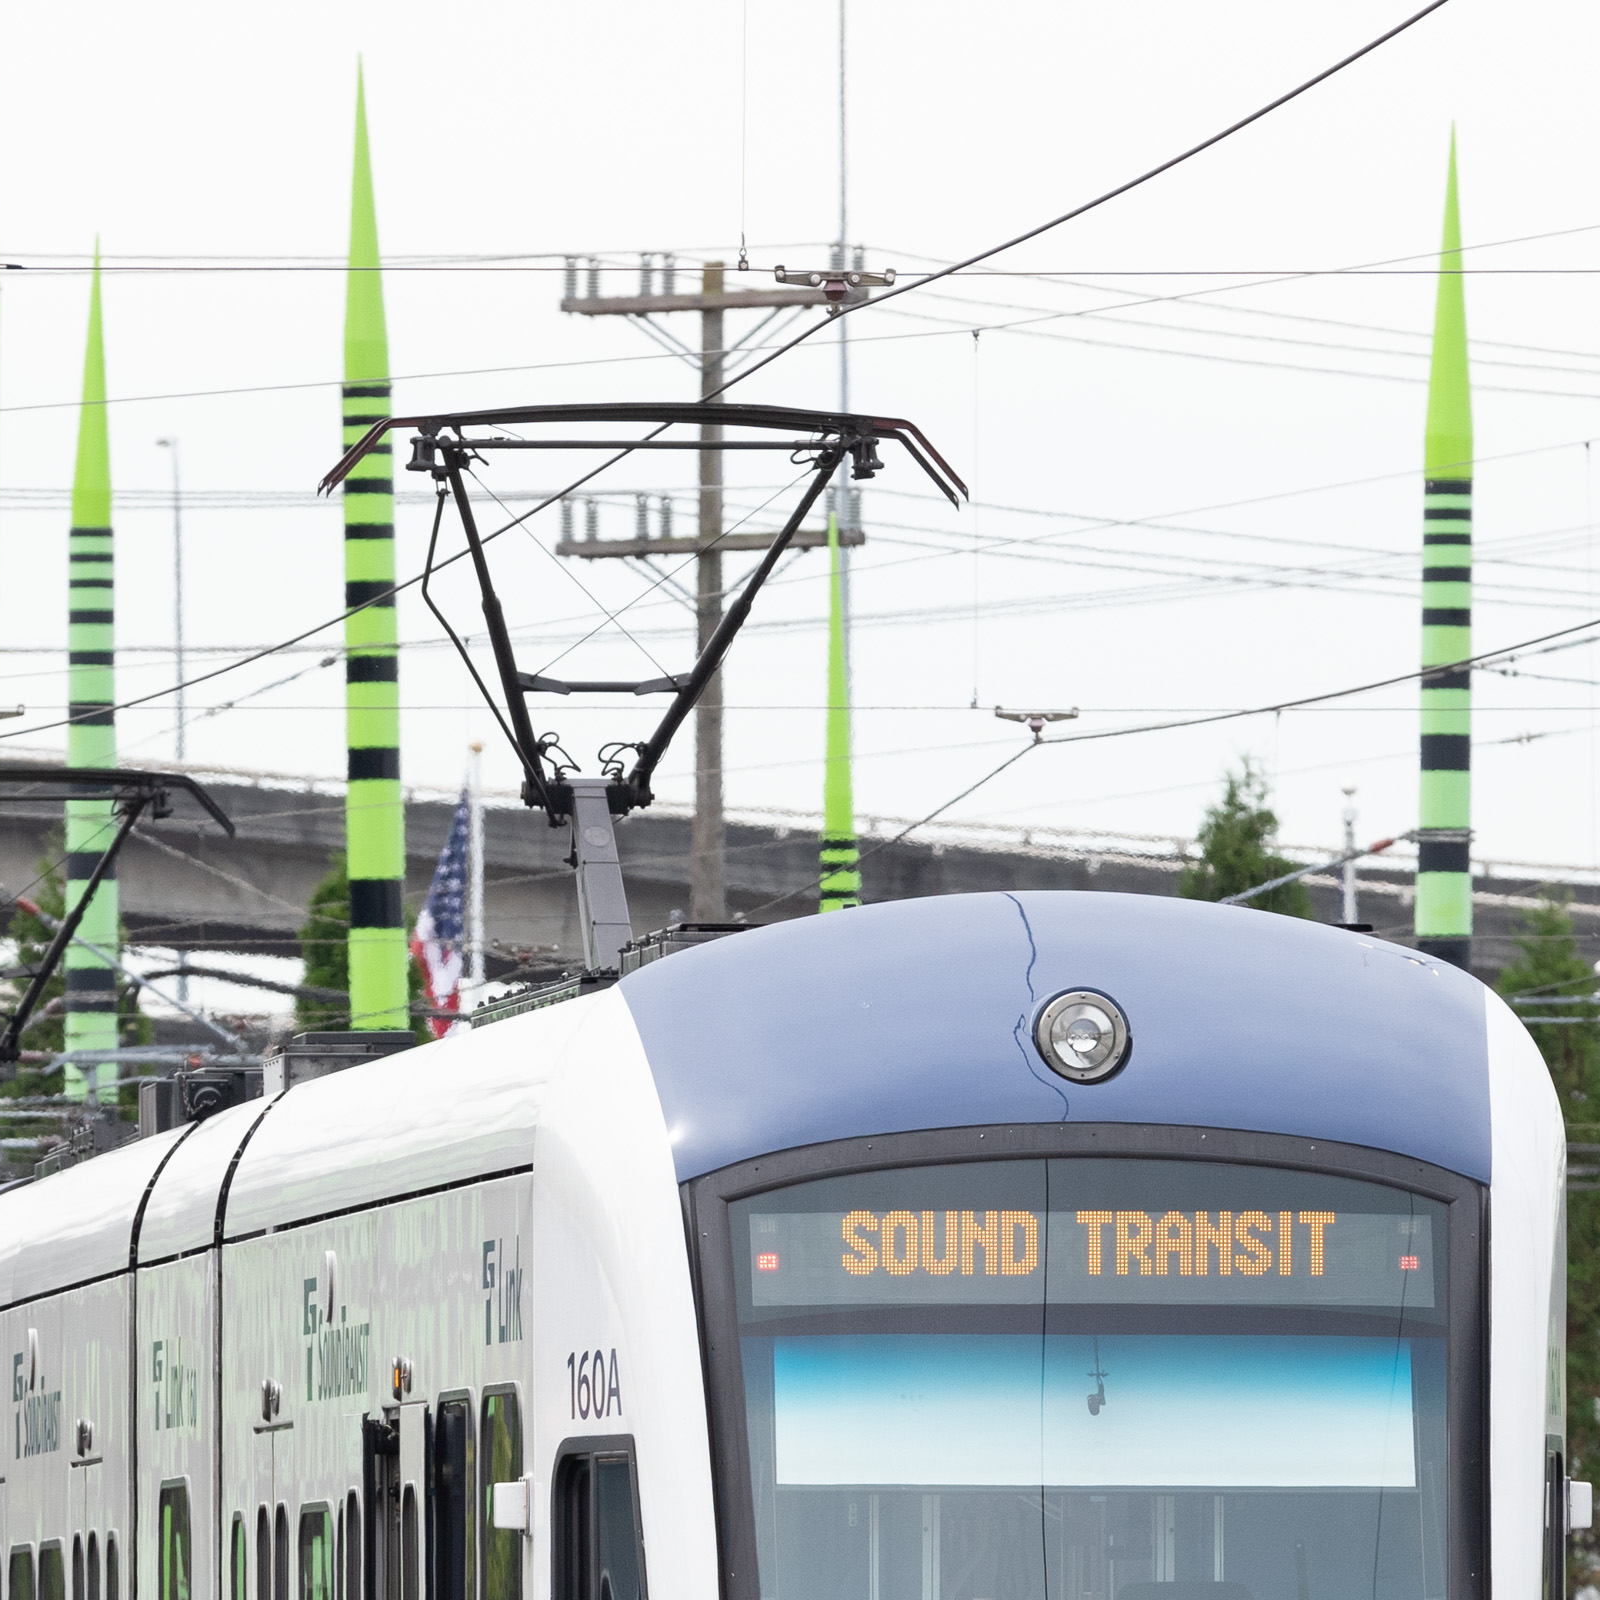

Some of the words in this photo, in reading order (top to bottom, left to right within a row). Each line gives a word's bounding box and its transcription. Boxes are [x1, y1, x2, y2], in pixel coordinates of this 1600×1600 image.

[842, 1210, 1038, 1276] SOUND
[1076, 1210, 1336, 1277] TRANSIT
[567, 1348, 622, 1420] 160A
